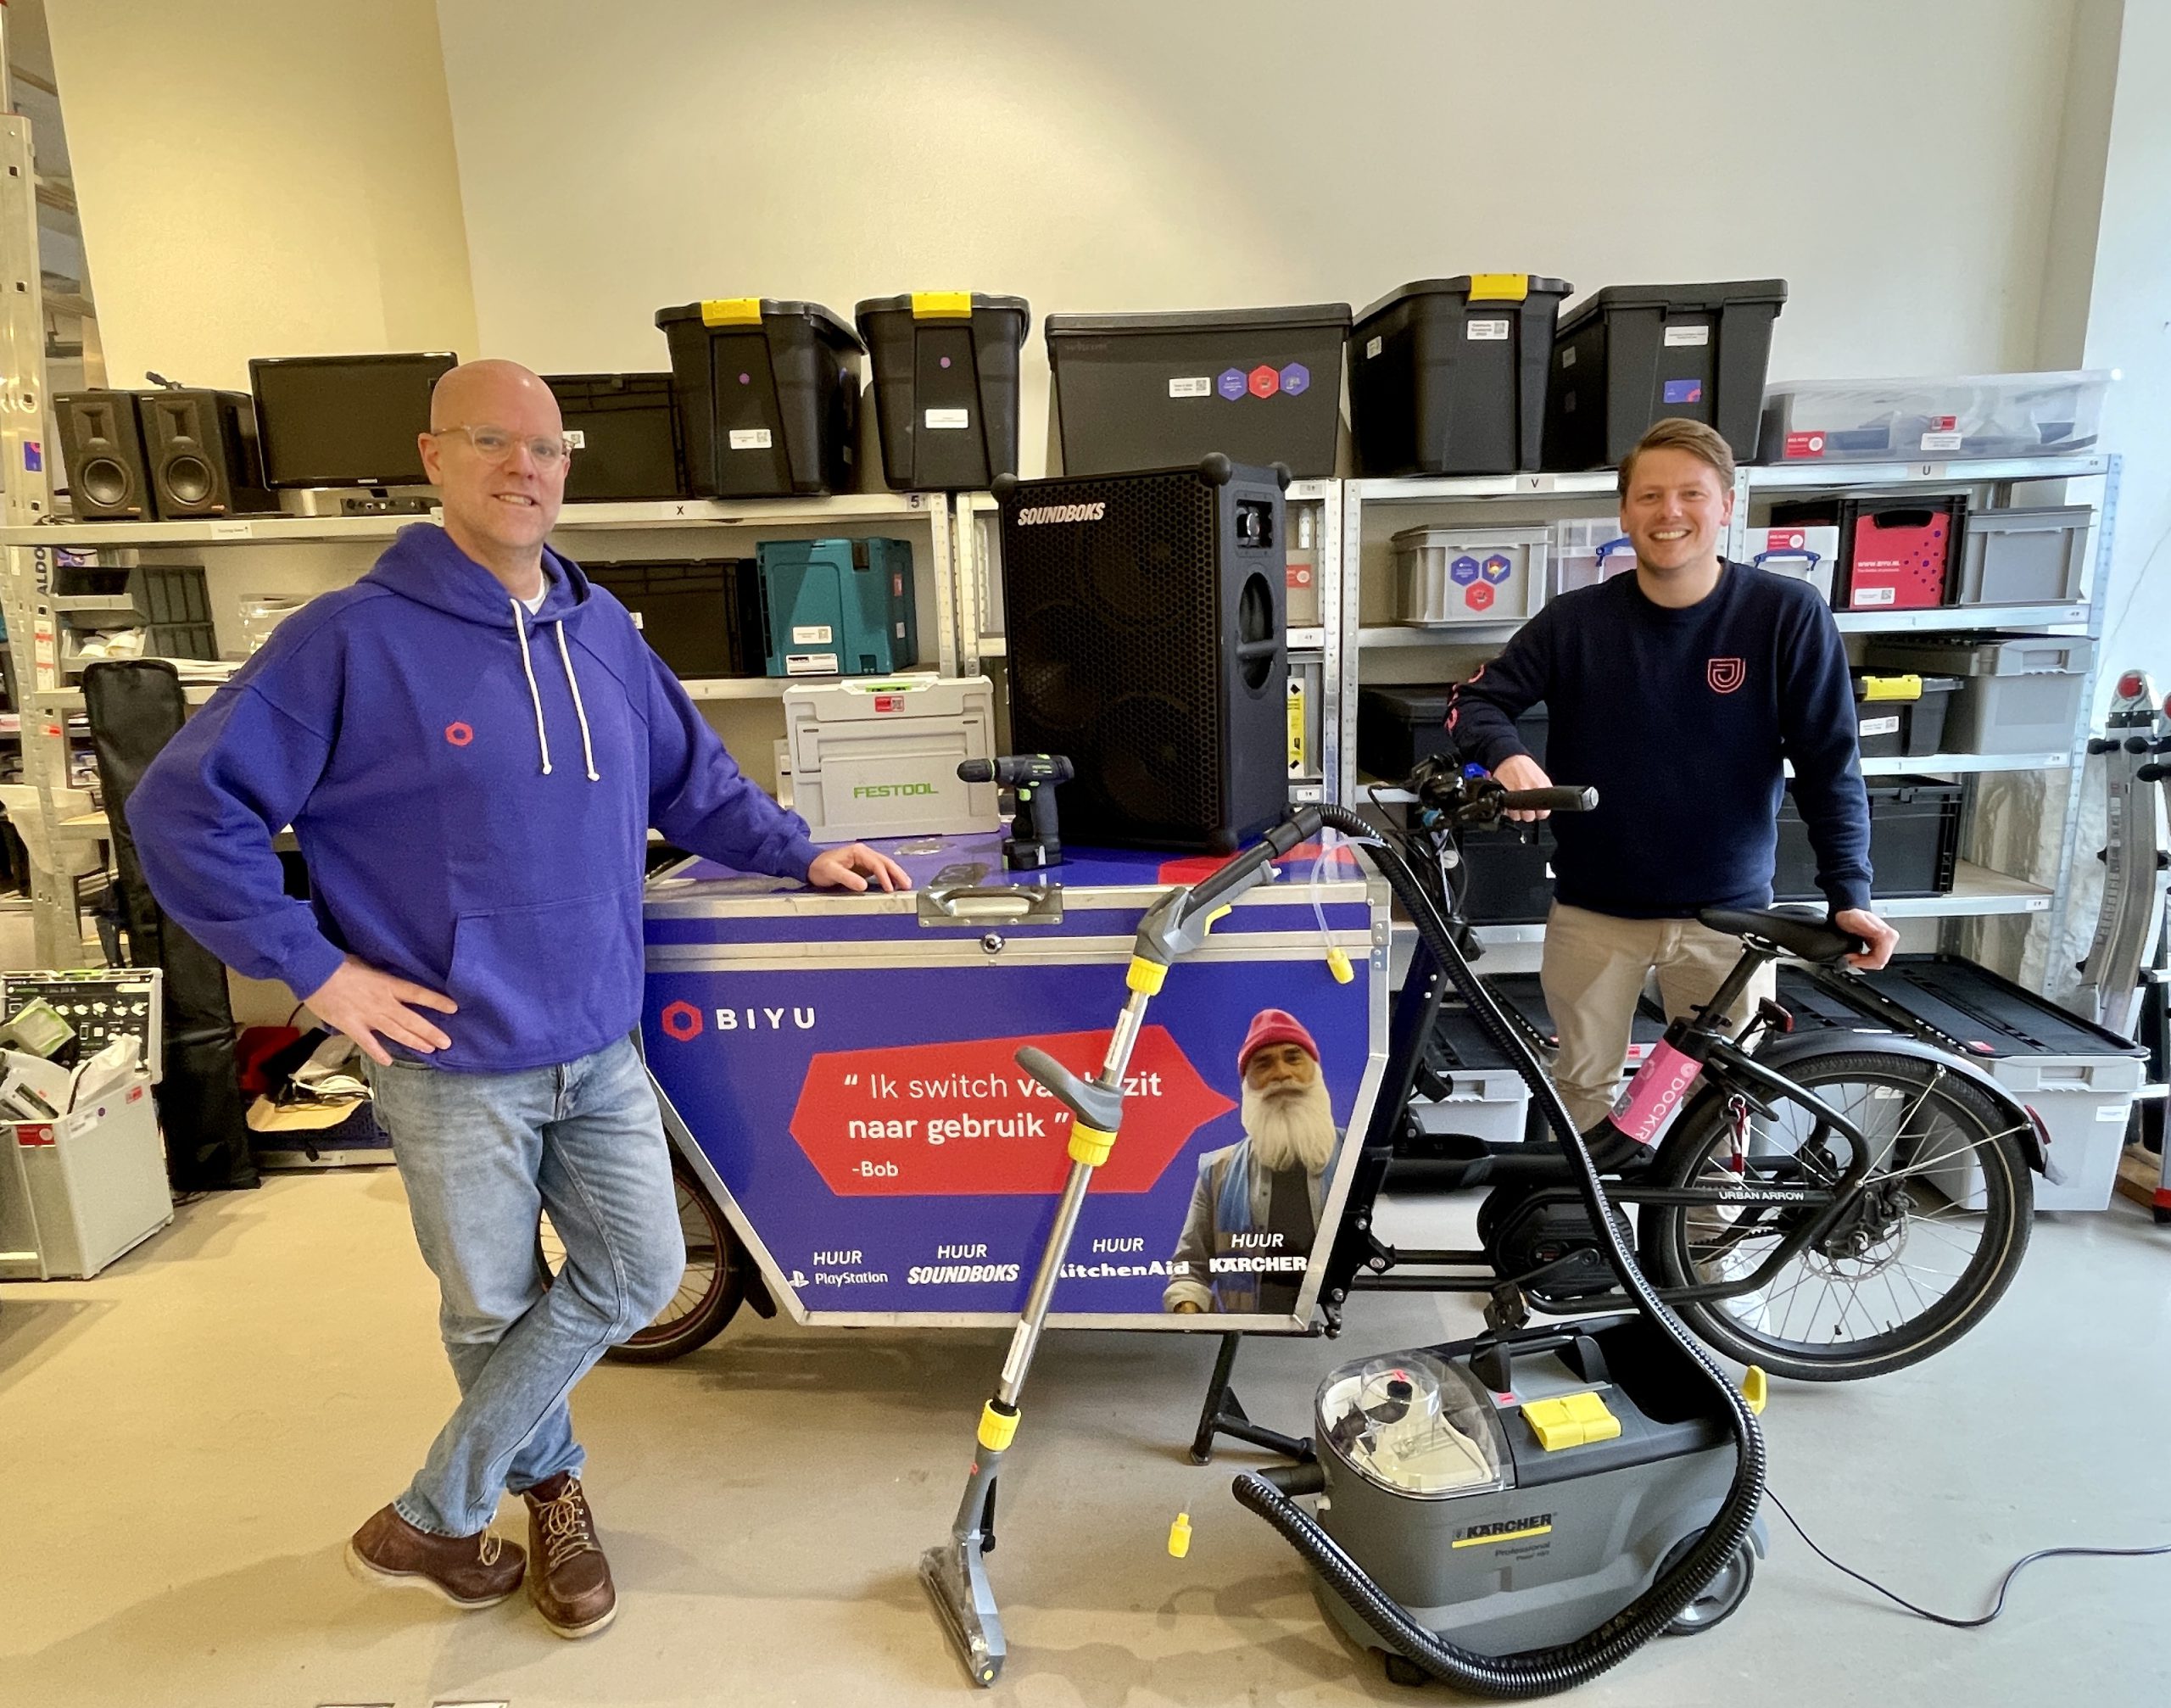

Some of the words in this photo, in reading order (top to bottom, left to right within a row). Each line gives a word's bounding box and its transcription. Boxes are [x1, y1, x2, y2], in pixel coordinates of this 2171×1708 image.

[1923, 466, 1931, 476] U
[1531, 478, 1539, 488] V
[911, 495, 920, 509] 5
[676, 505, 684, 516] X
[1018, 502, 1106, 526] SOUNDBOKS
[853, 783, 939, 799] FESTOOL
[716, 1007, 815, 1030] BIYU
[870, 1073, 899, 1099] Ik
[908, 1072, 1007, 1098] switch
[1017, 1078, 1054, 1097] va
[1635, 1077, 1685, 1140] DOCKR
[849, 1119, 918, 1139] naar
[928, 1112, 1046, 1145] gebruik
[851, 1160, 899, 1177] -Bob
[1718, 1191, 1760, 1200] URBAN
[1761, 1192, 1804, 1201] ARROW
[1092, 1237, 1144, 1253] HUUR
[1231, 1233, 1285, 1248] HUUR
[813, 1250, 862, 1265] HUUR
[937, 1243, 988, 1259] HUUR
[815, 1271, 889, 1287] PlayStation
[907, 1264, 1020, 1285] SOUNDBOKS
[1495, 1542, 1551, 1557] Professional
